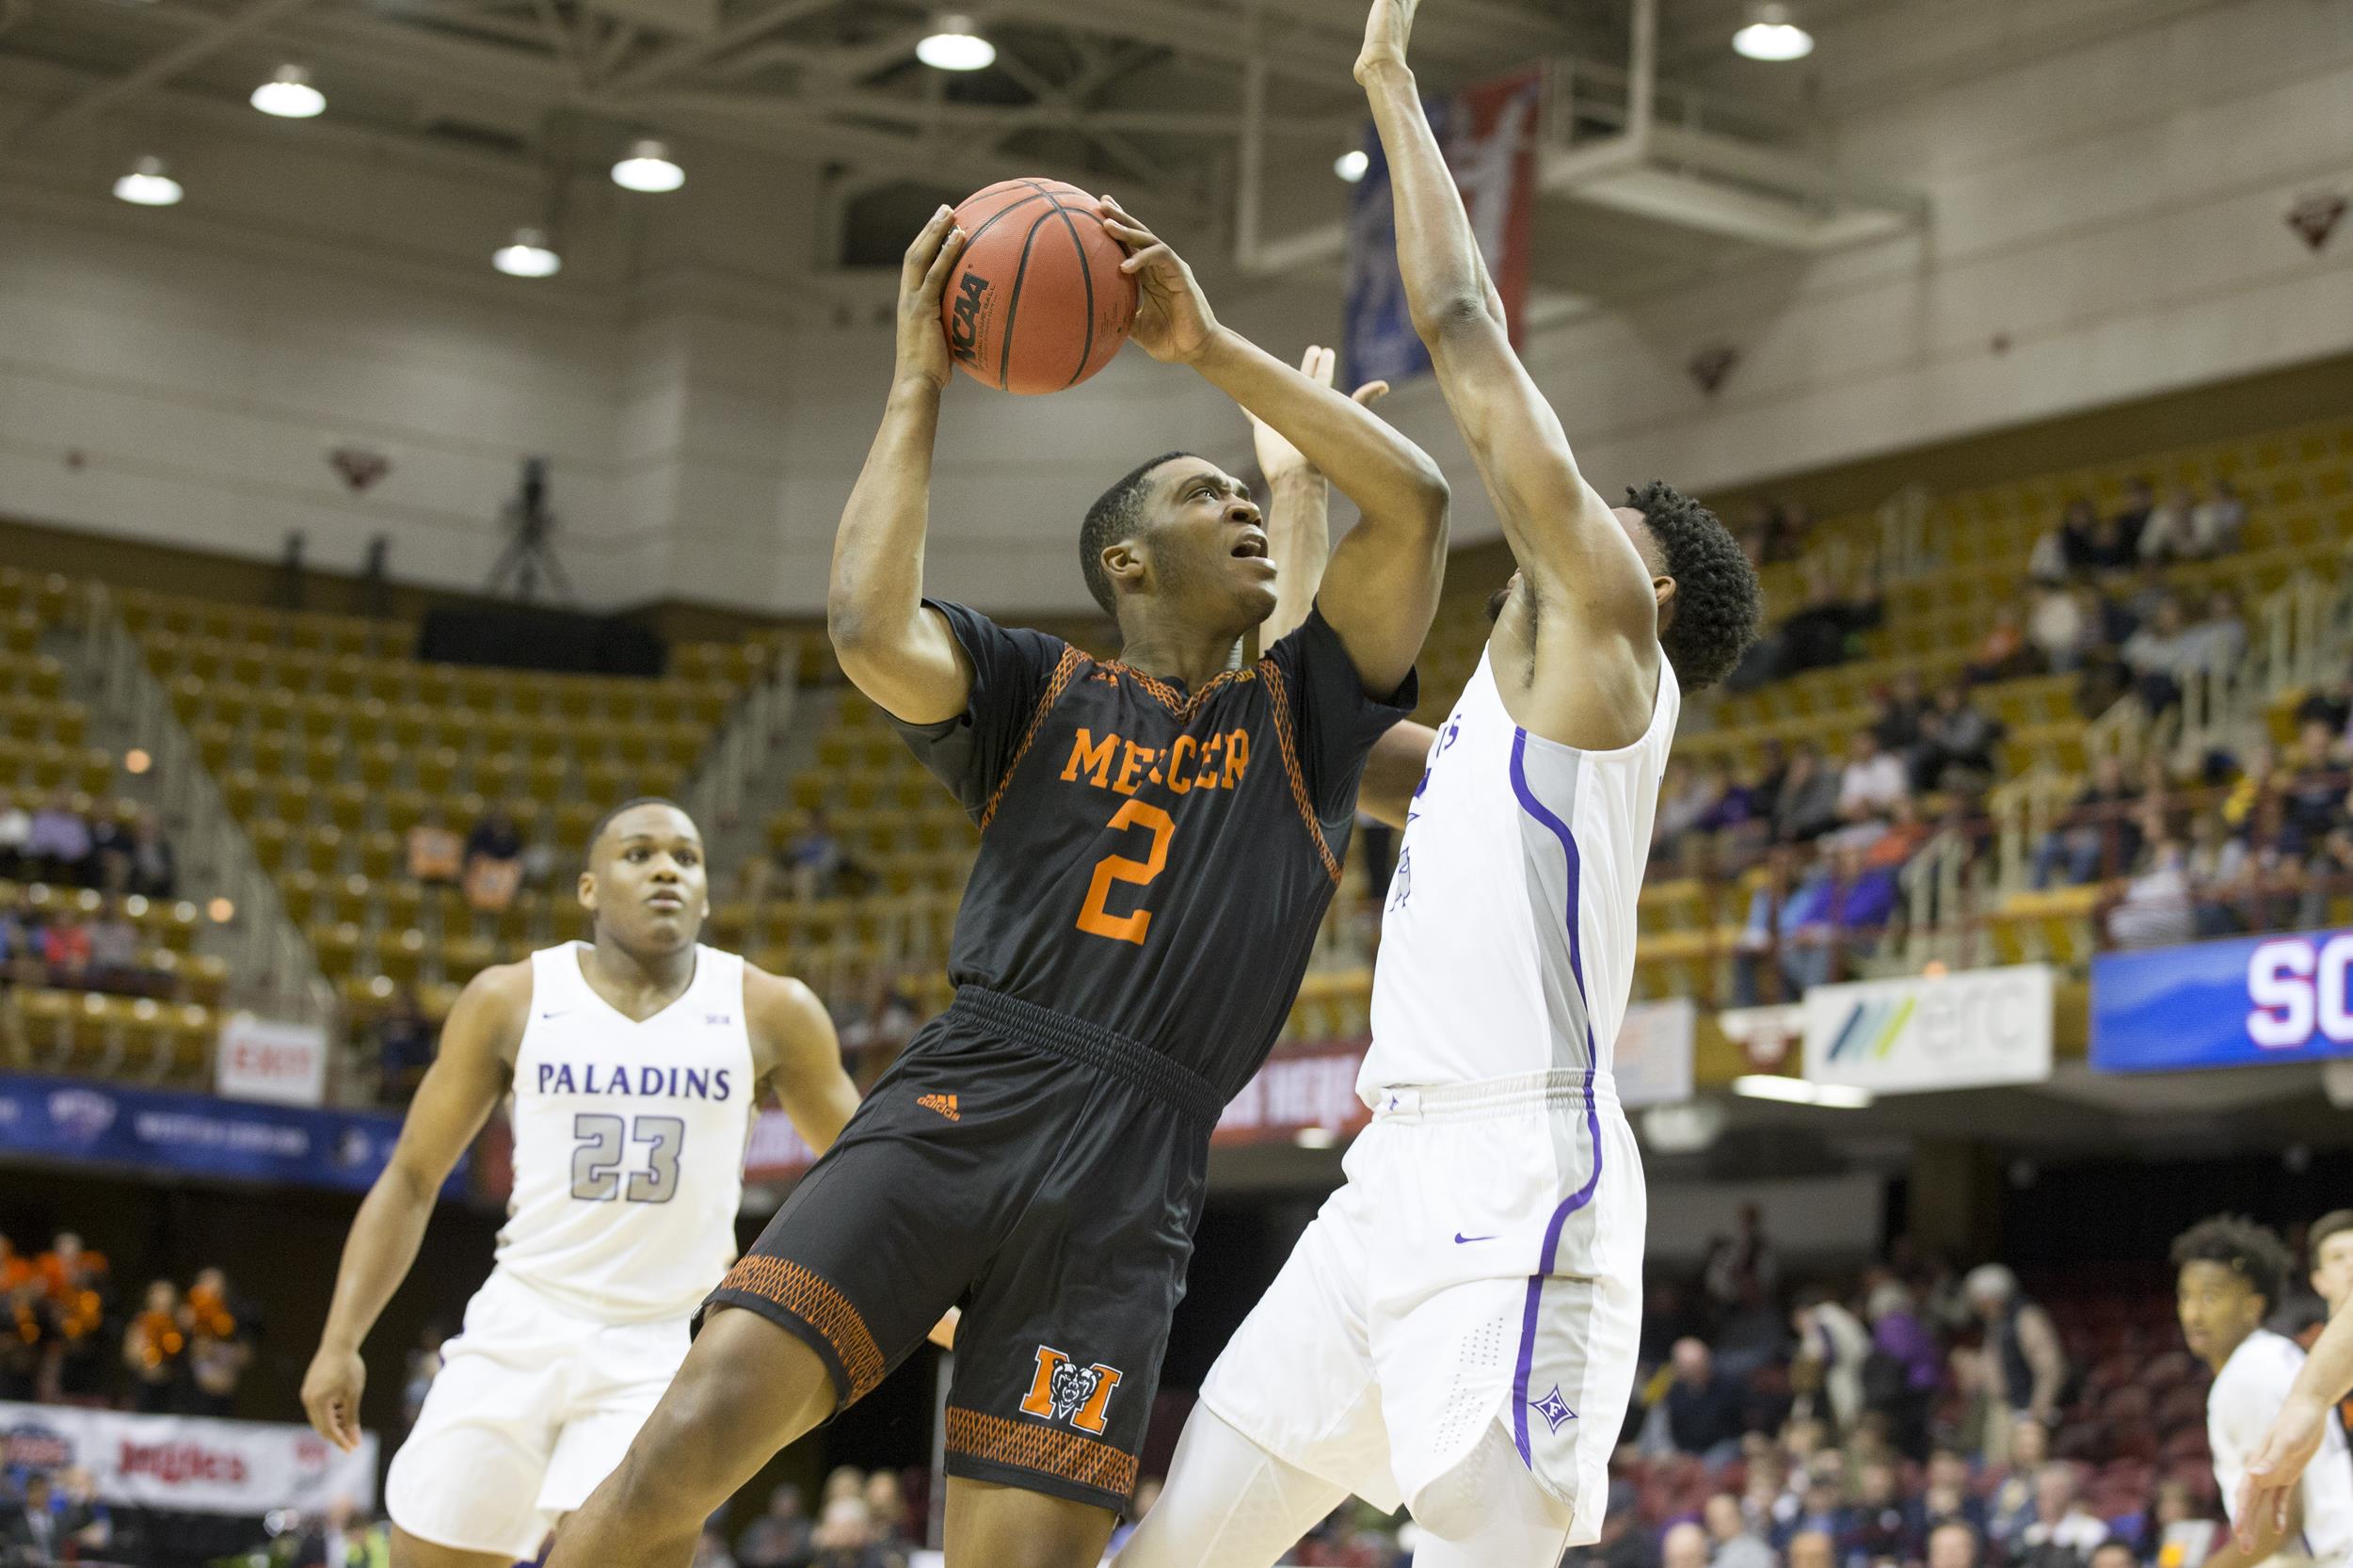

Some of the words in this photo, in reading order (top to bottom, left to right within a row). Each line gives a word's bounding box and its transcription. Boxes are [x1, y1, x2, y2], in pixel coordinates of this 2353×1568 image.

[952, 271, 989, 369] NCAA
[1075, 798, 1176, 946] 2
[1918, 980, 2032, 1058] erc
[537, 1063, 731, 1102] PALADINS
[917, 1096, 961, 1122] adidas
[571, 1112, 685, 1204] 23
